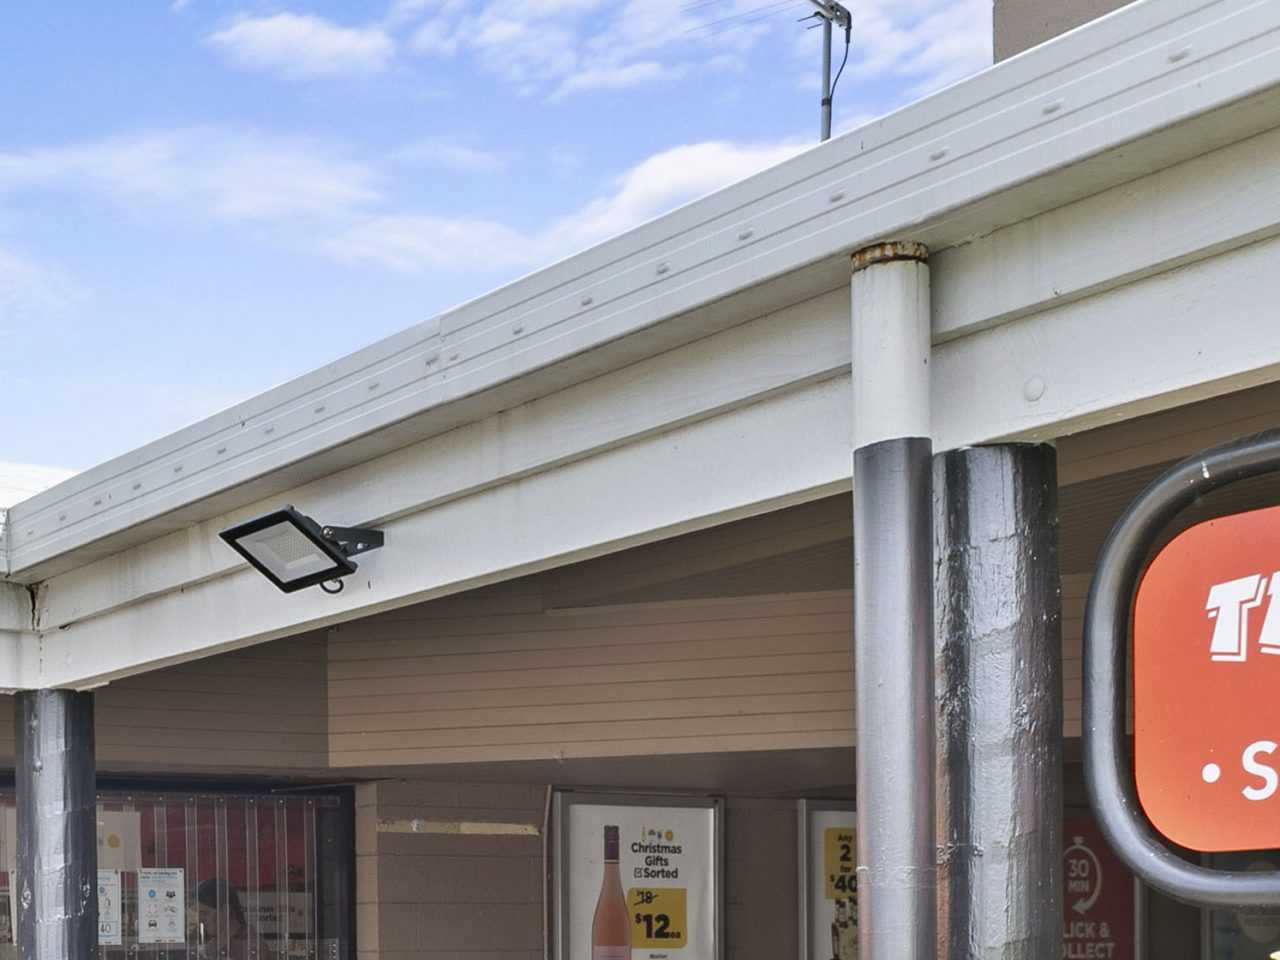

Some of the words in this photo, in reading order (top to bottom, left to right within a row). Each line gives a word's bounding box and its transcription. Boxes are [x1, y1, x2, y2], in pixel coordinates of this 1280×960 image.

[631, 842, 682, 855] Christmas
[839, 844, 852, 862] 2
[644, 855, 669, 867] Gifts
[1069, 859, 1090, 877] 30
[643, 868, 679, 879] Sorted
[1068, 880, 1090, 893] MIN
[1063, 922, 1096, 938] LICK
[1063, 942, 1115, 959] LLECT
